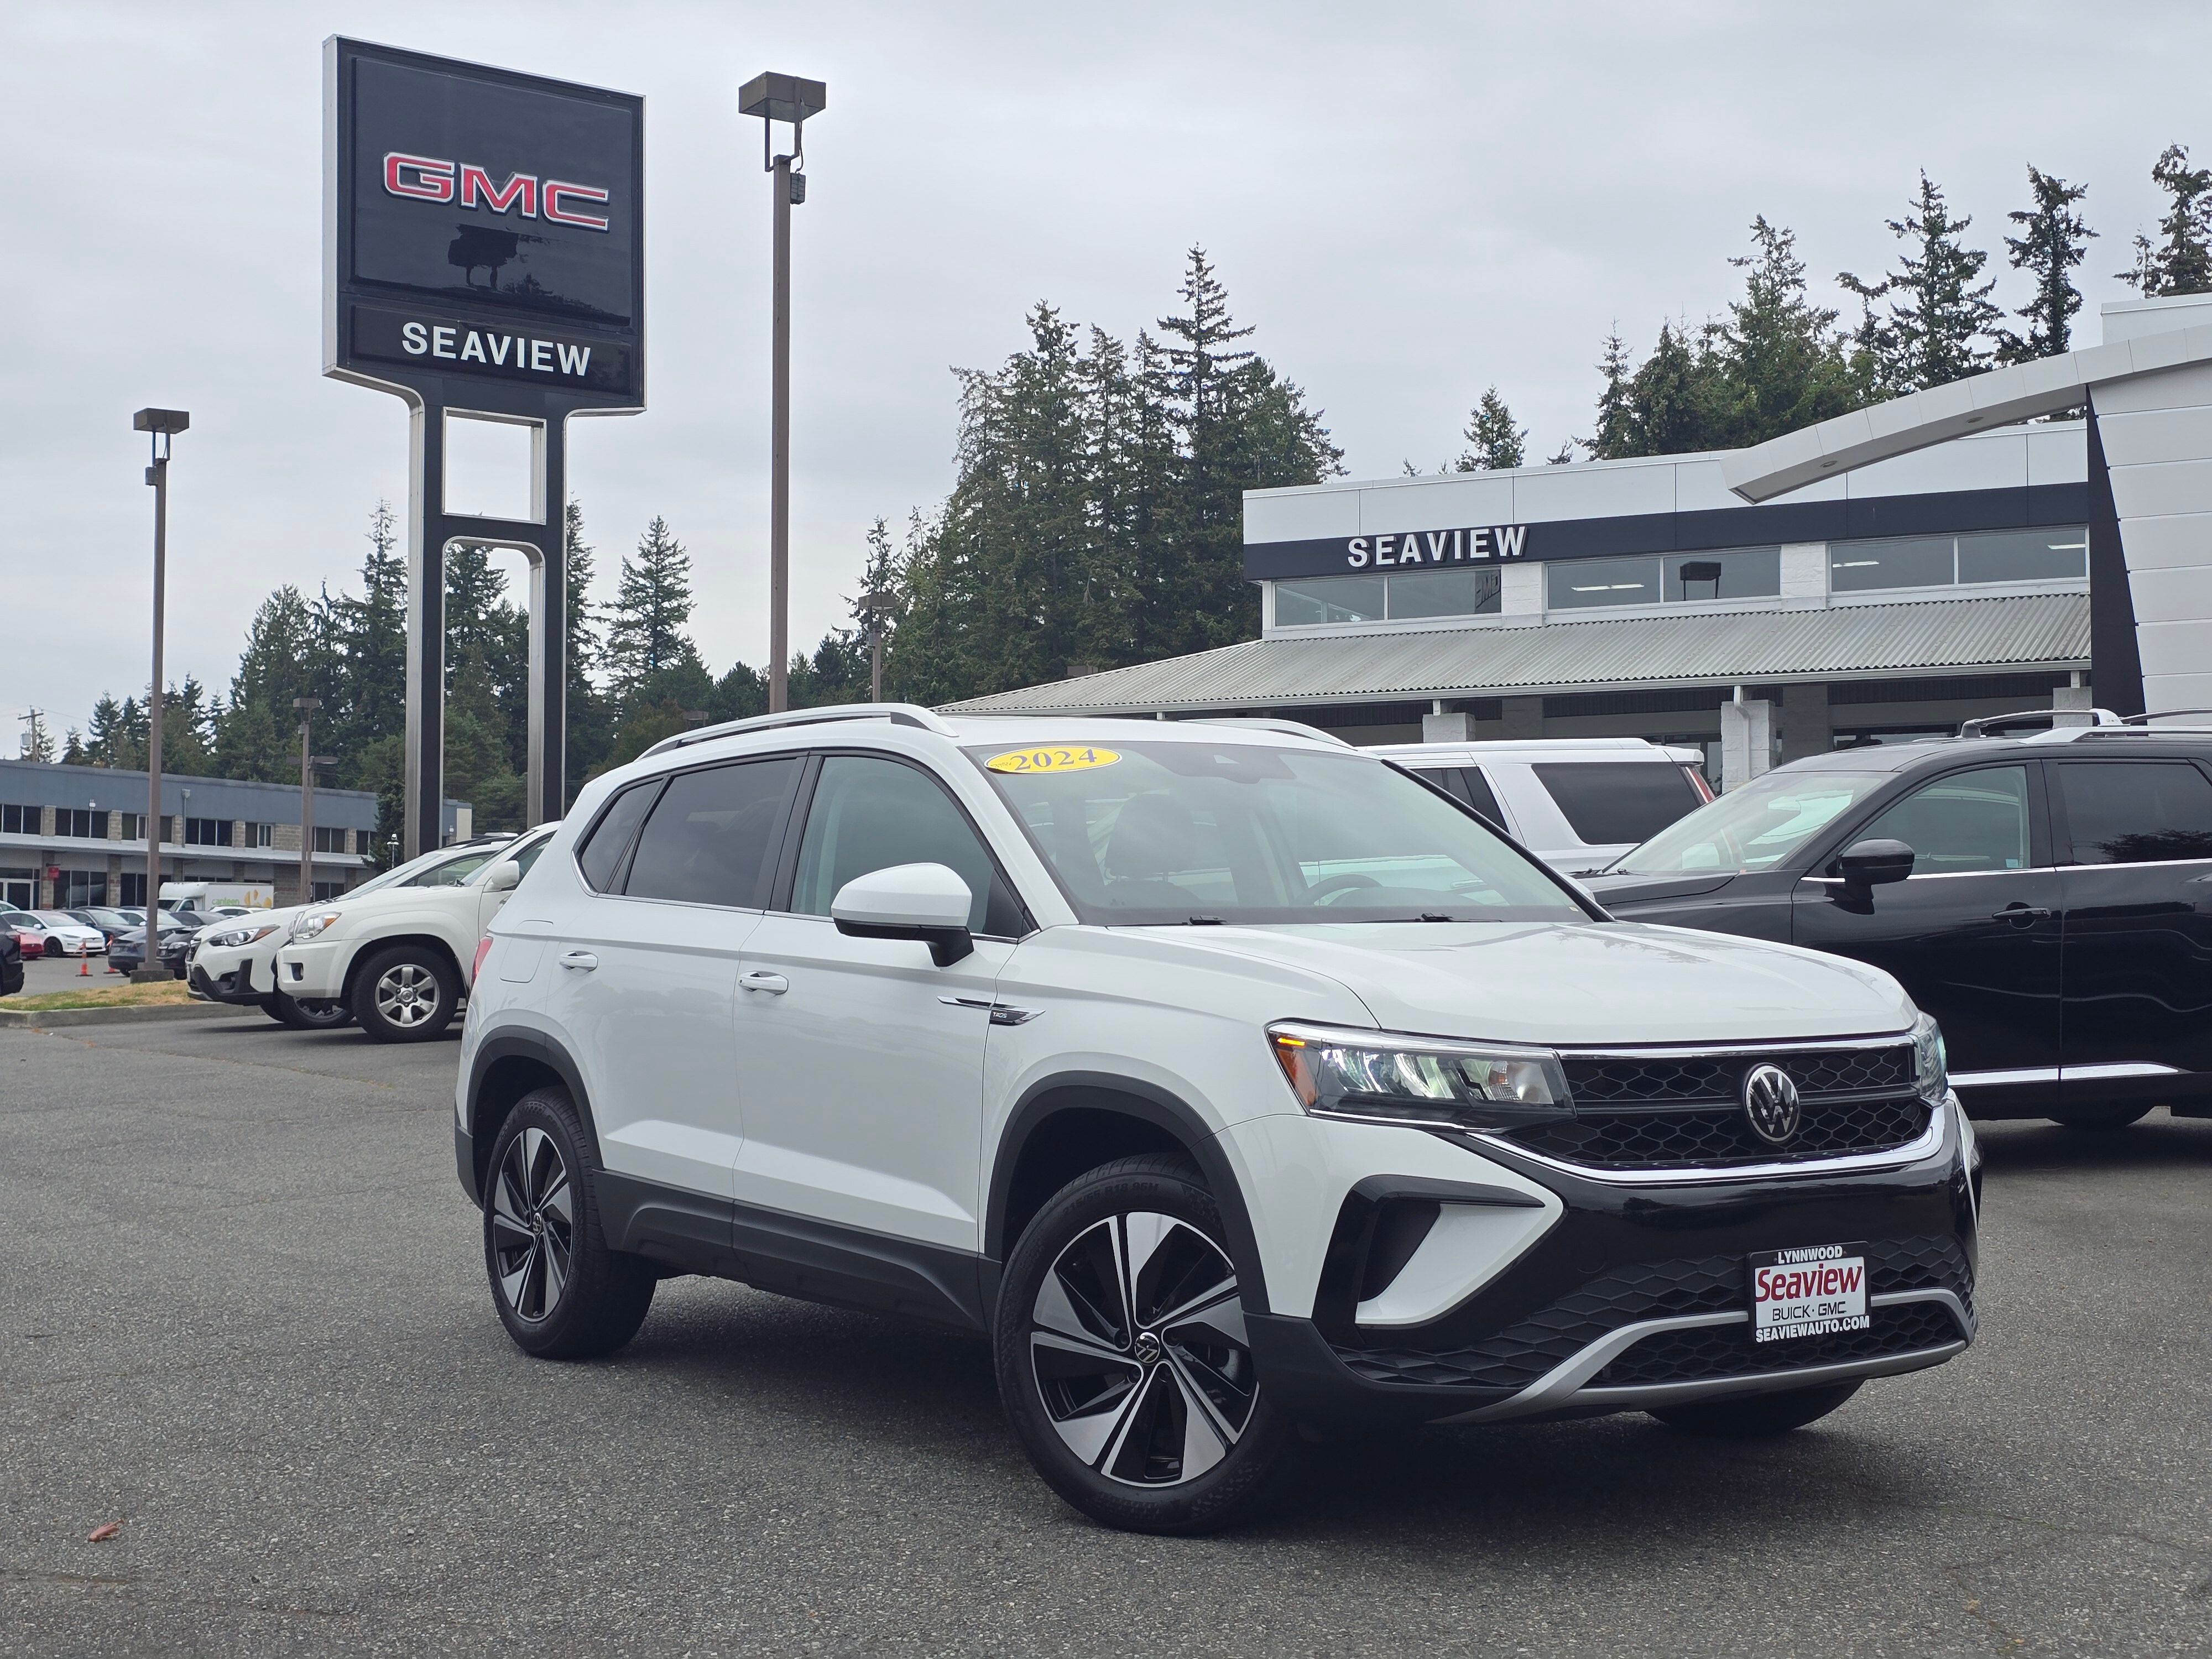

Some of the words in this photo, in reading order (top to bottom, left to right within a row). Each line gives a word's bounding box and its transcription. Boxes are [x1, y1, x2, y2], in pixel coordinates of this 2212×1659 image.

[383, 151, 609, 231] GMC
[402, 322, 591, 376] SEAVIEW
[1347, 525, 1528, 568] SEAVIEW
[1010, 748, 1098, 771] 2024
[211, 897, 239, 906] canteen
[1778, 1245, 1843, 1264] LYNNWOOD
[1755, 1263, 1863, 1302] Seaview
[1772, 1304, 1811, 1322] BUICK
[1818, 1301, 1847, 1317] GMC
[1755, 1315, 1870, 1343] SEAVIEWAUTO.COM
